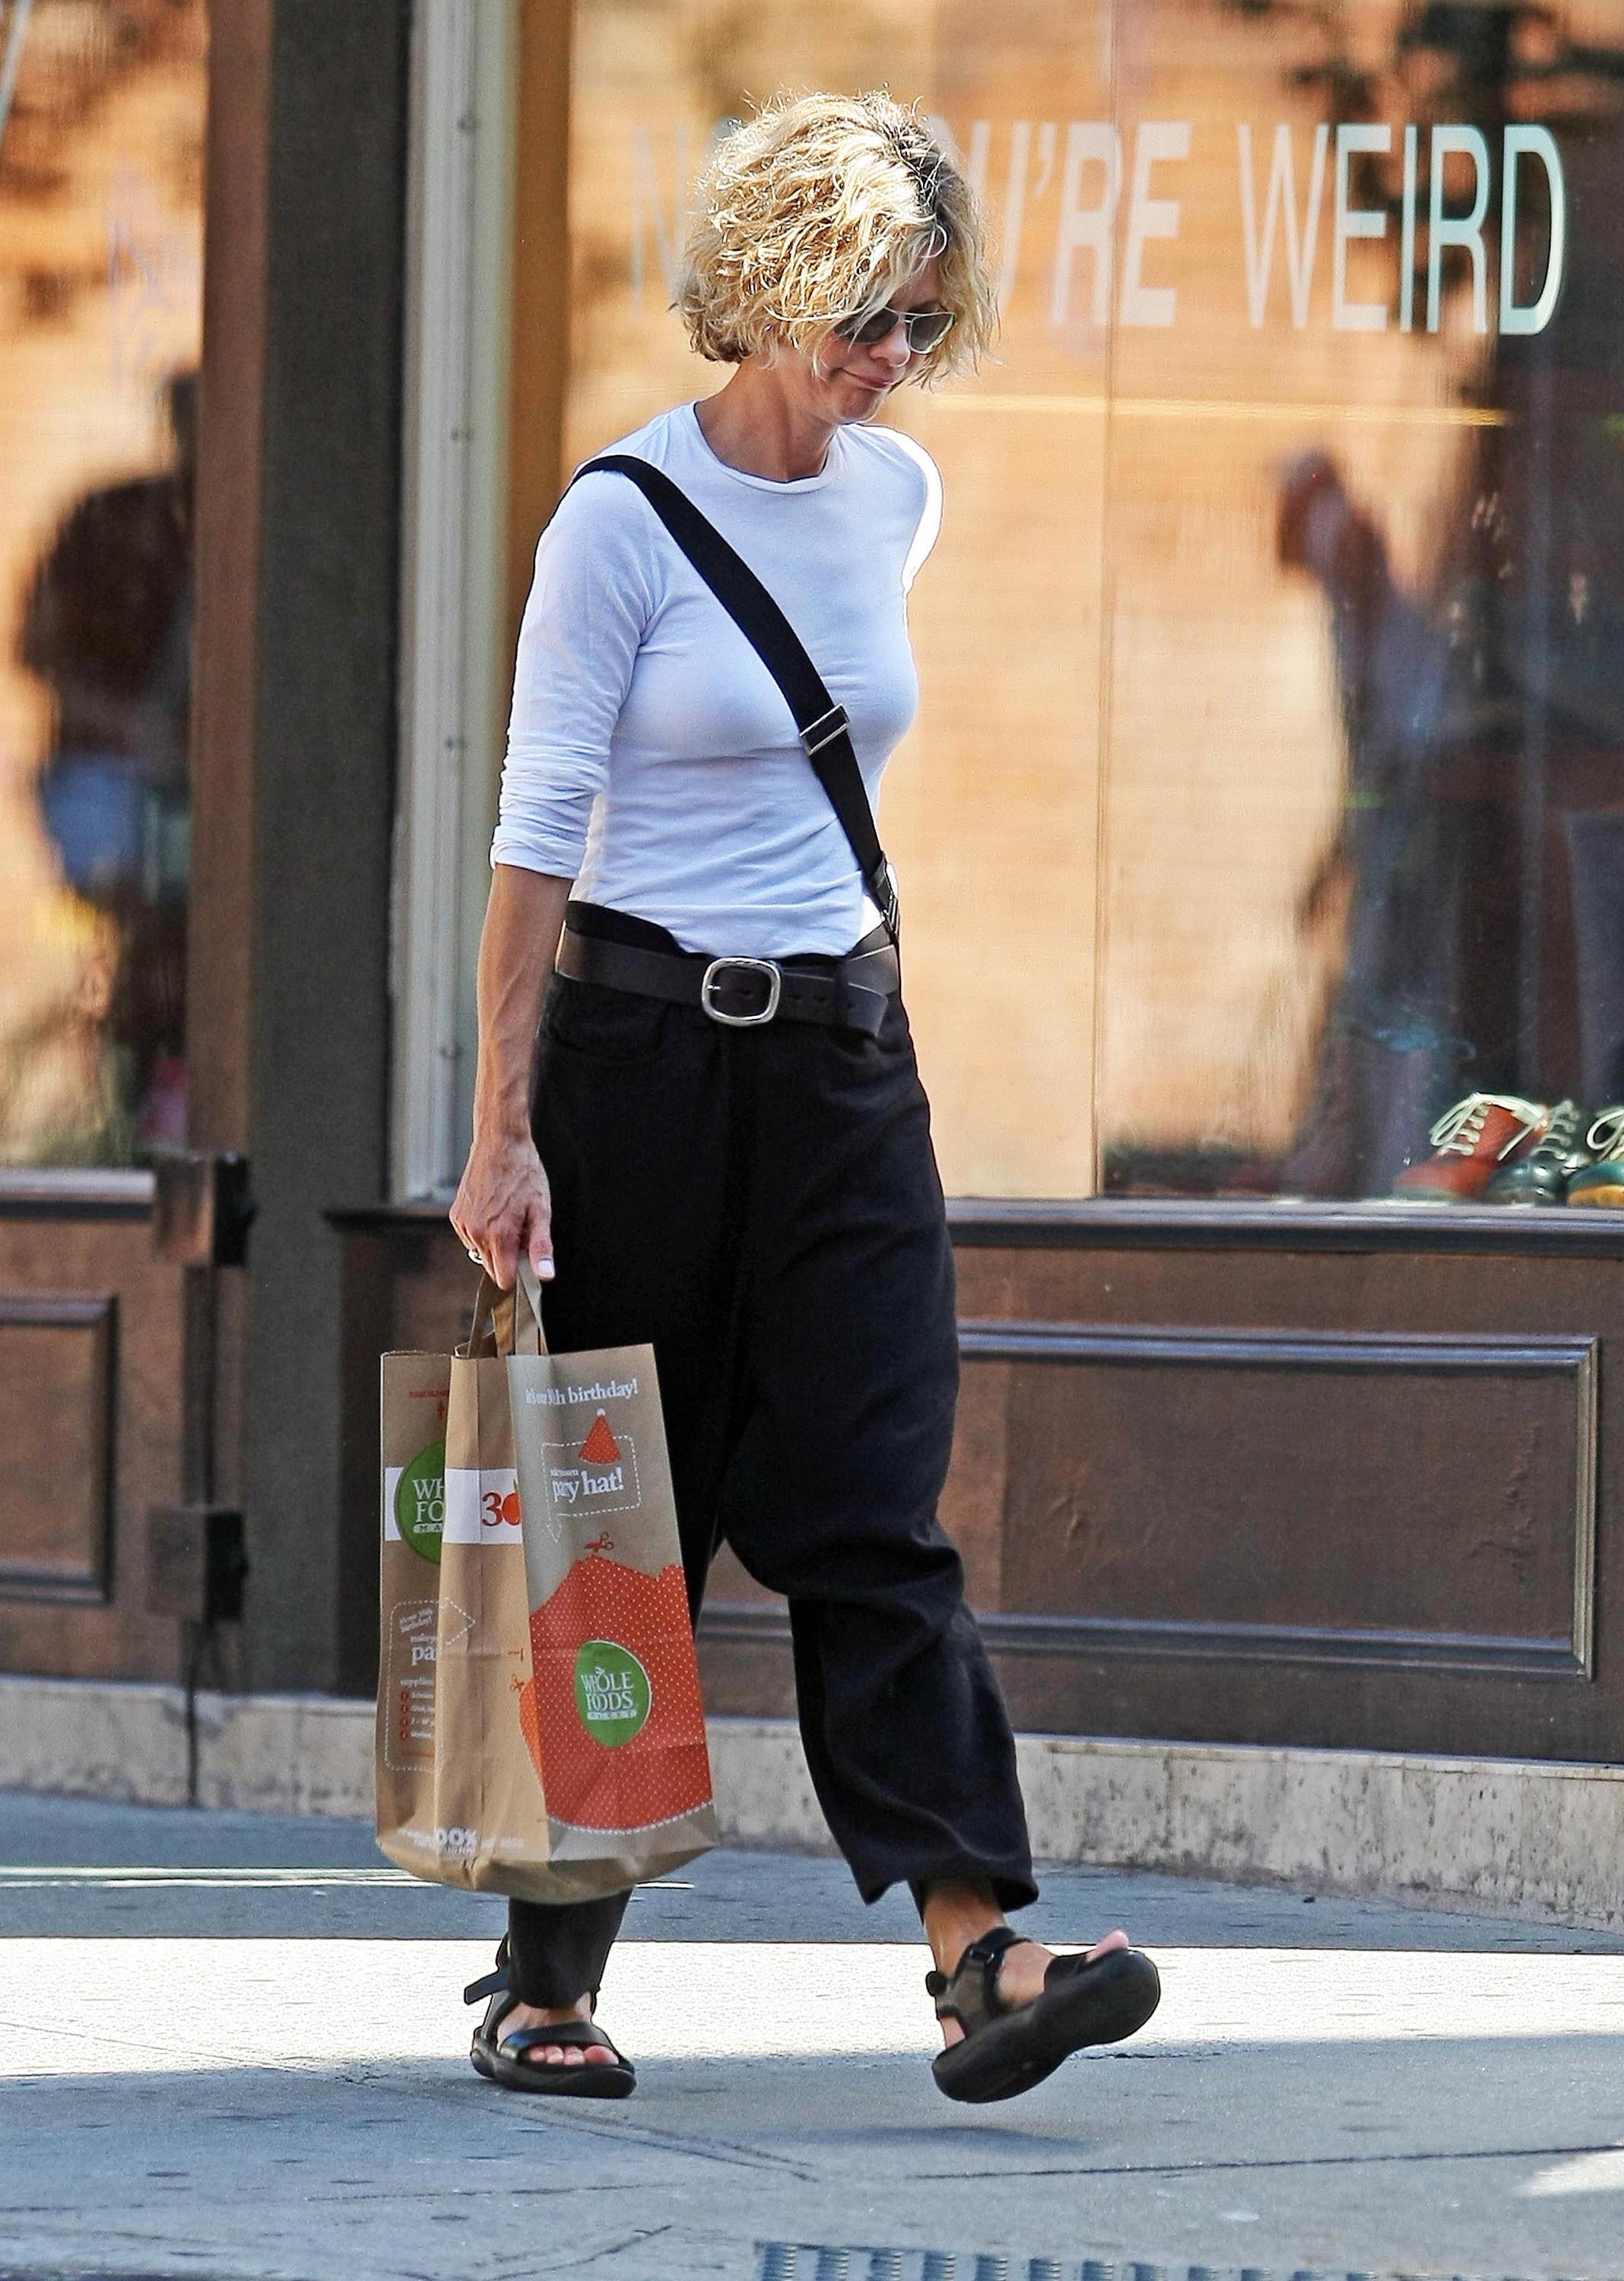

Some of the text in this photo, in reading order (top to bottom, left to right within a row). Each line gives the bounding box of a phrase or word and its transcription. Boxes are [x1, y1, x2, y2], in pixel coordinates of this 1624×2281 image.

[1235, 122, 1565, 335] WEIRD
[567, 1378, 639, 1403] birthday!
[580, 1466, 624, 1496] hat!
[580, 1670, 634, 1693] WHOLE
[585, 1690, 634, 1712] FOODS
